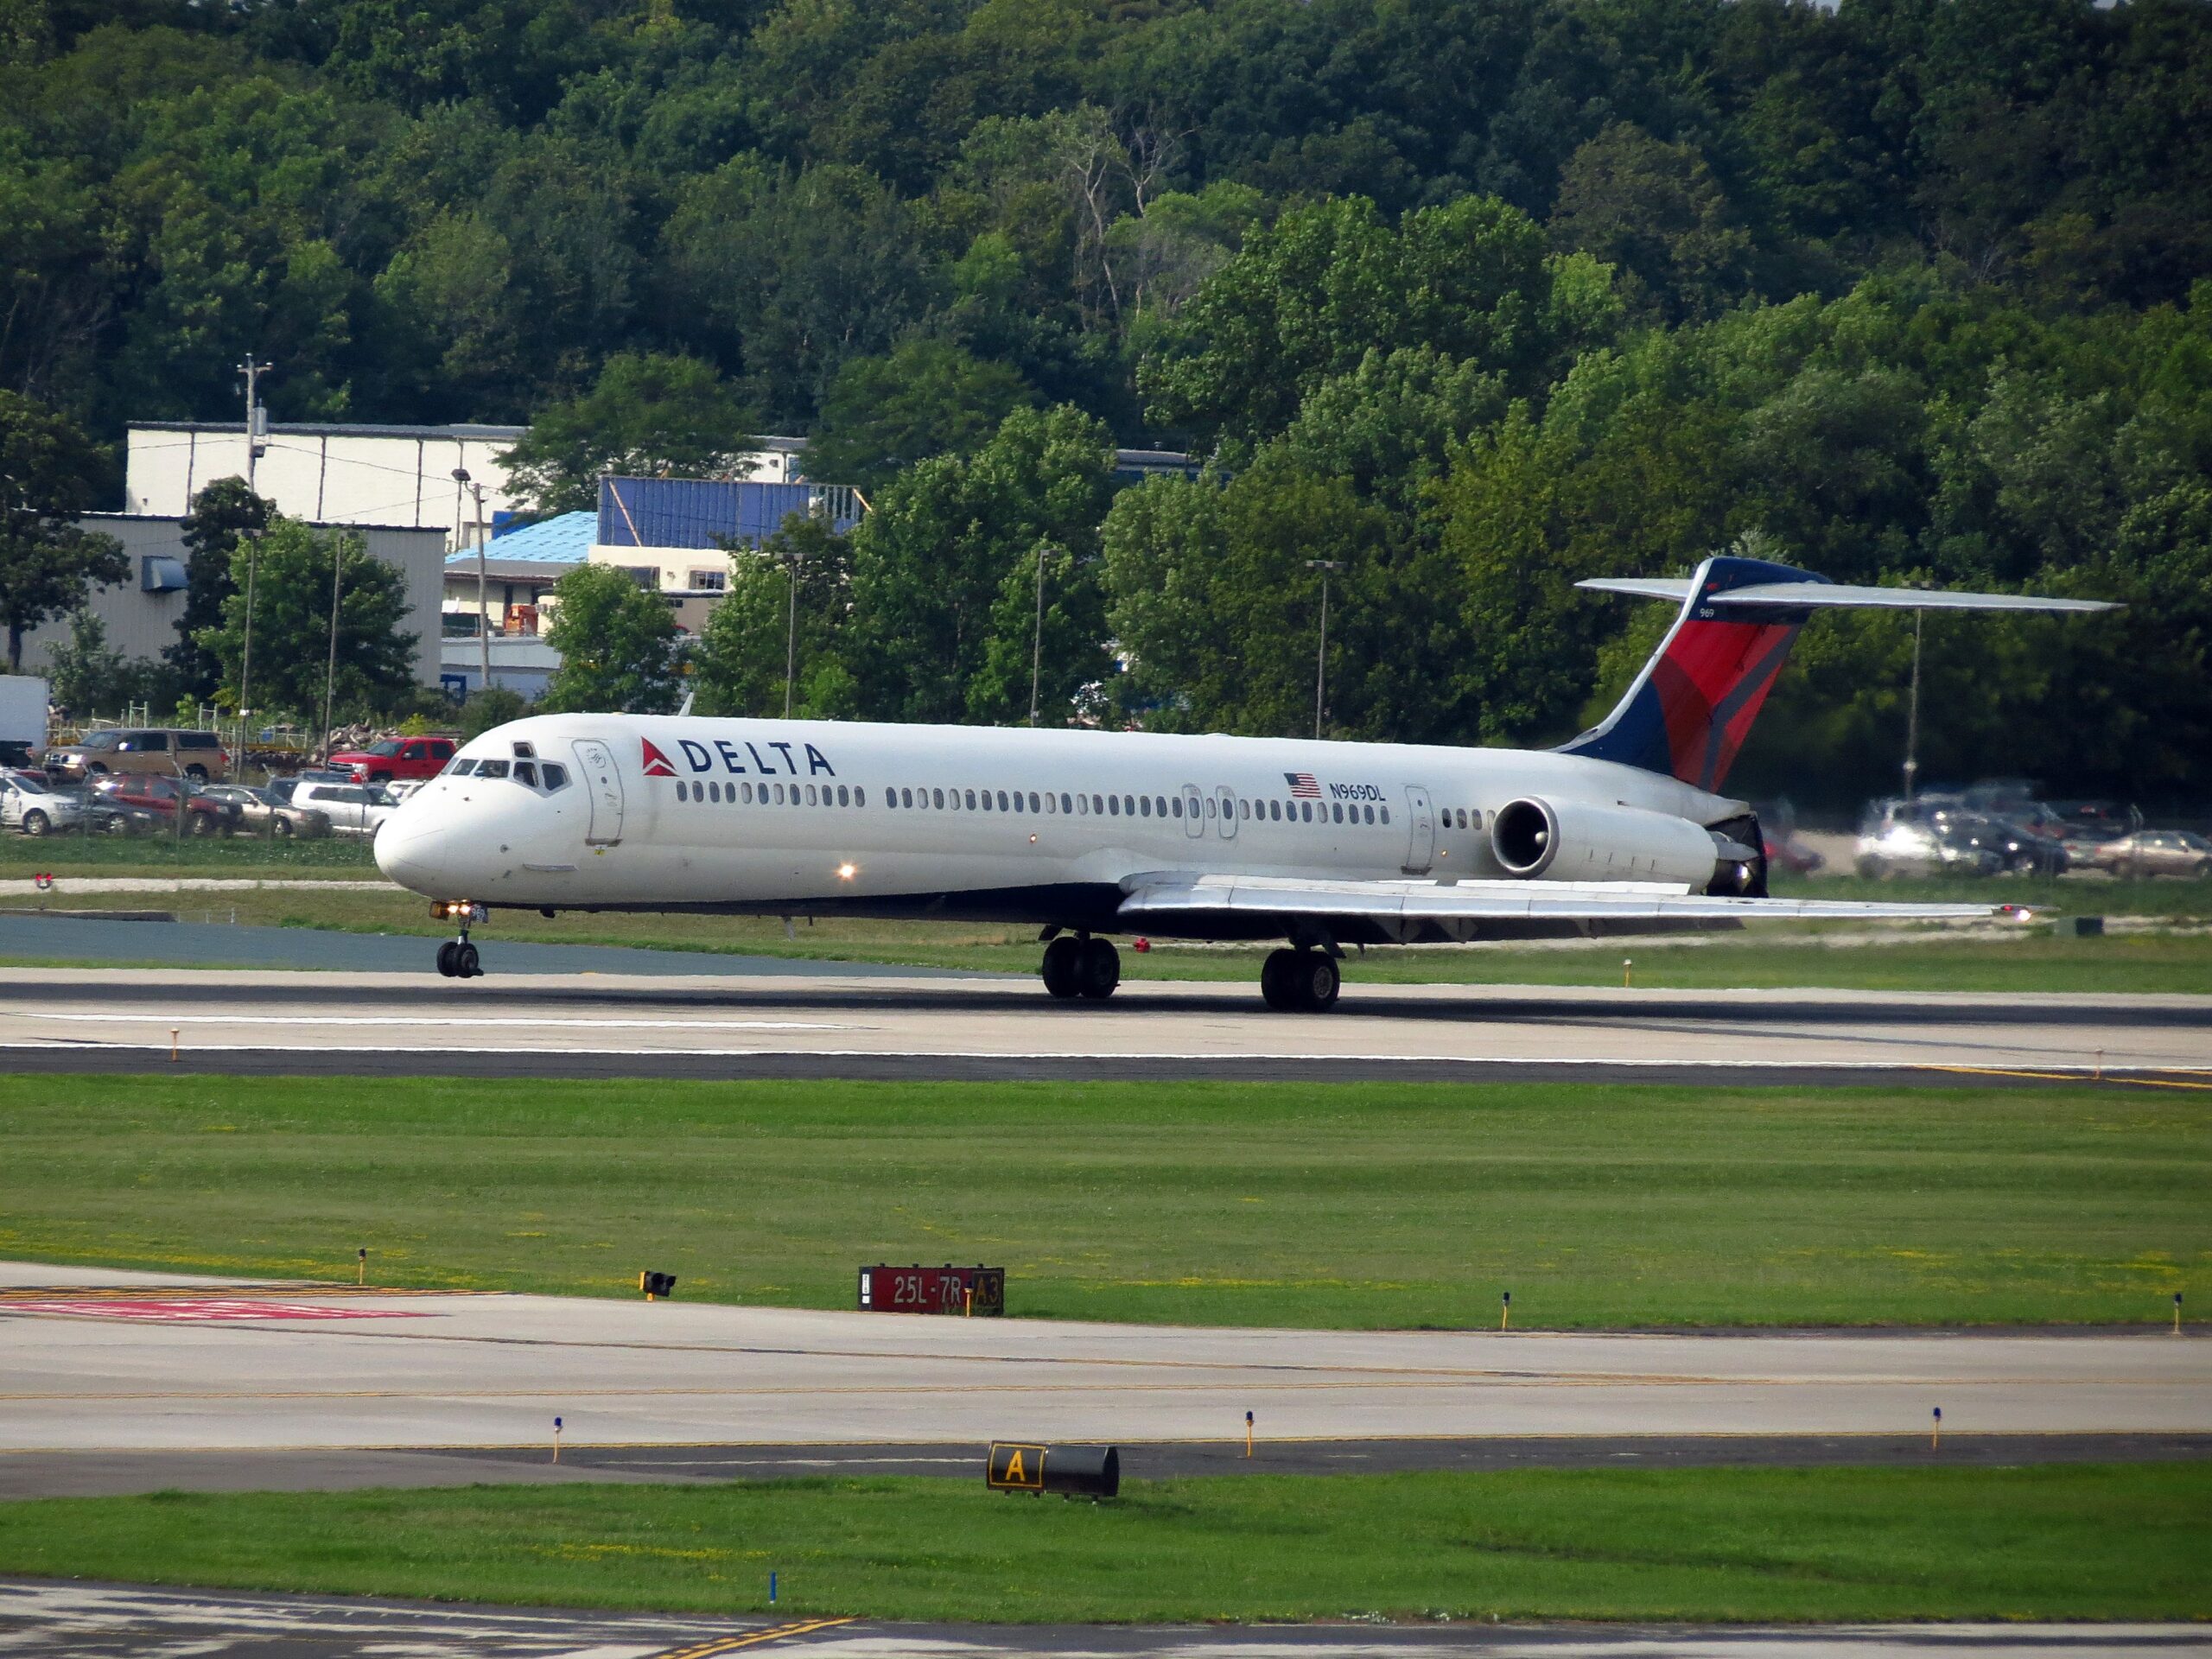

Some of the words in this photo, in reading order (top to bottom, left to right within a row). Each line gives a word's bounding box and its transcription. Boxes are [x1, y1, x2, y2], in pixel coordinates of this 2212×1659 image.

[1700, 607, 1714, 618] 969
[677, 739, 836, 777] DELTA
[1329, 783, 1386, 802] N969DL
[976, 1276, 999, 1304] A3
[1005, 1450, 1026, 1482] A
